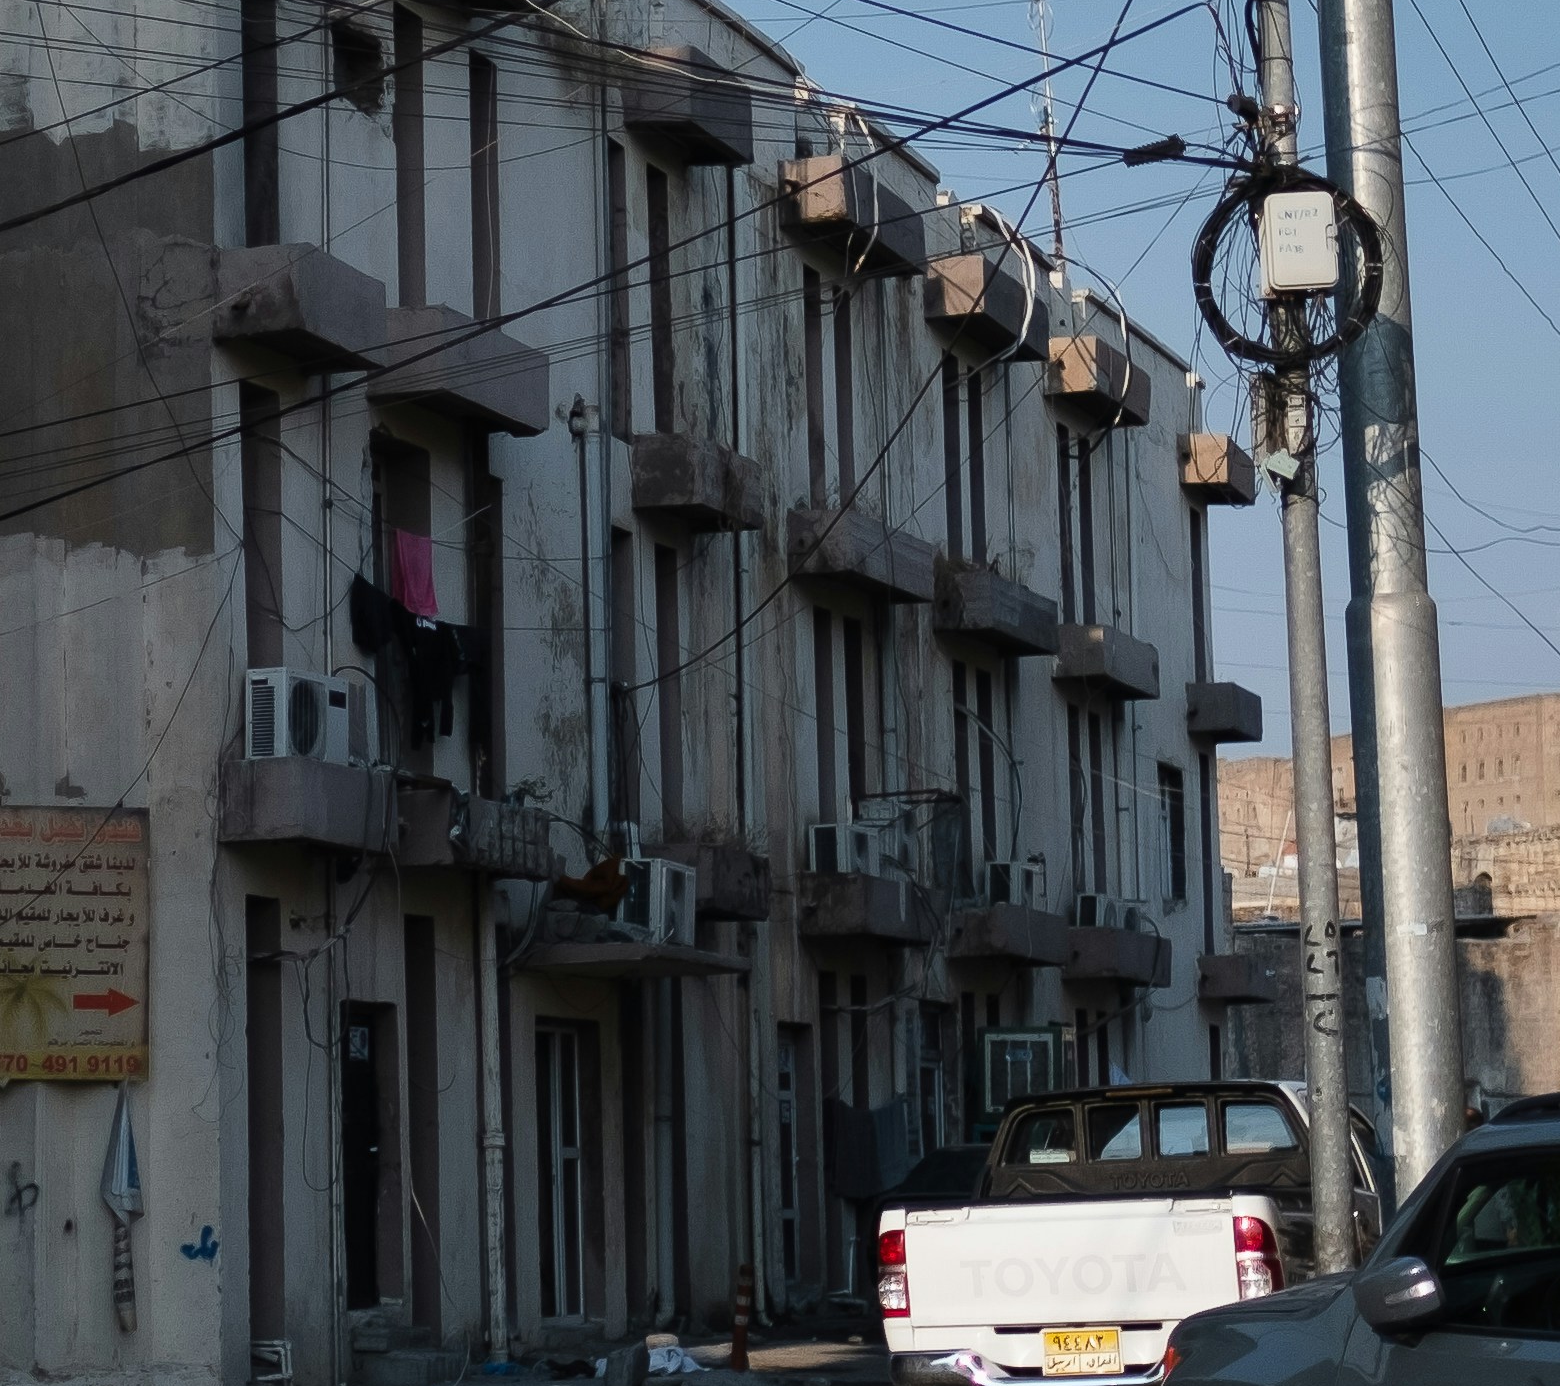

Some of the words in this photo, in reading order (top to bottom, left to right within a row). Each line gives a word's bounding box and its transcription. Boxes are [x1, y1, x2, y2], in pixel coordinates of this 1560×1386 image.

[105, 857, 136, 875] لدينا
[38, 933, 82, 952] خاص
[86, 934, 130, 952] جناح
[41, 1054, 78, 1073] 491
[1110, 1171, 1189, 1190] TOYOTA
[960, 1252, 1187, 1299] TOYOTA
